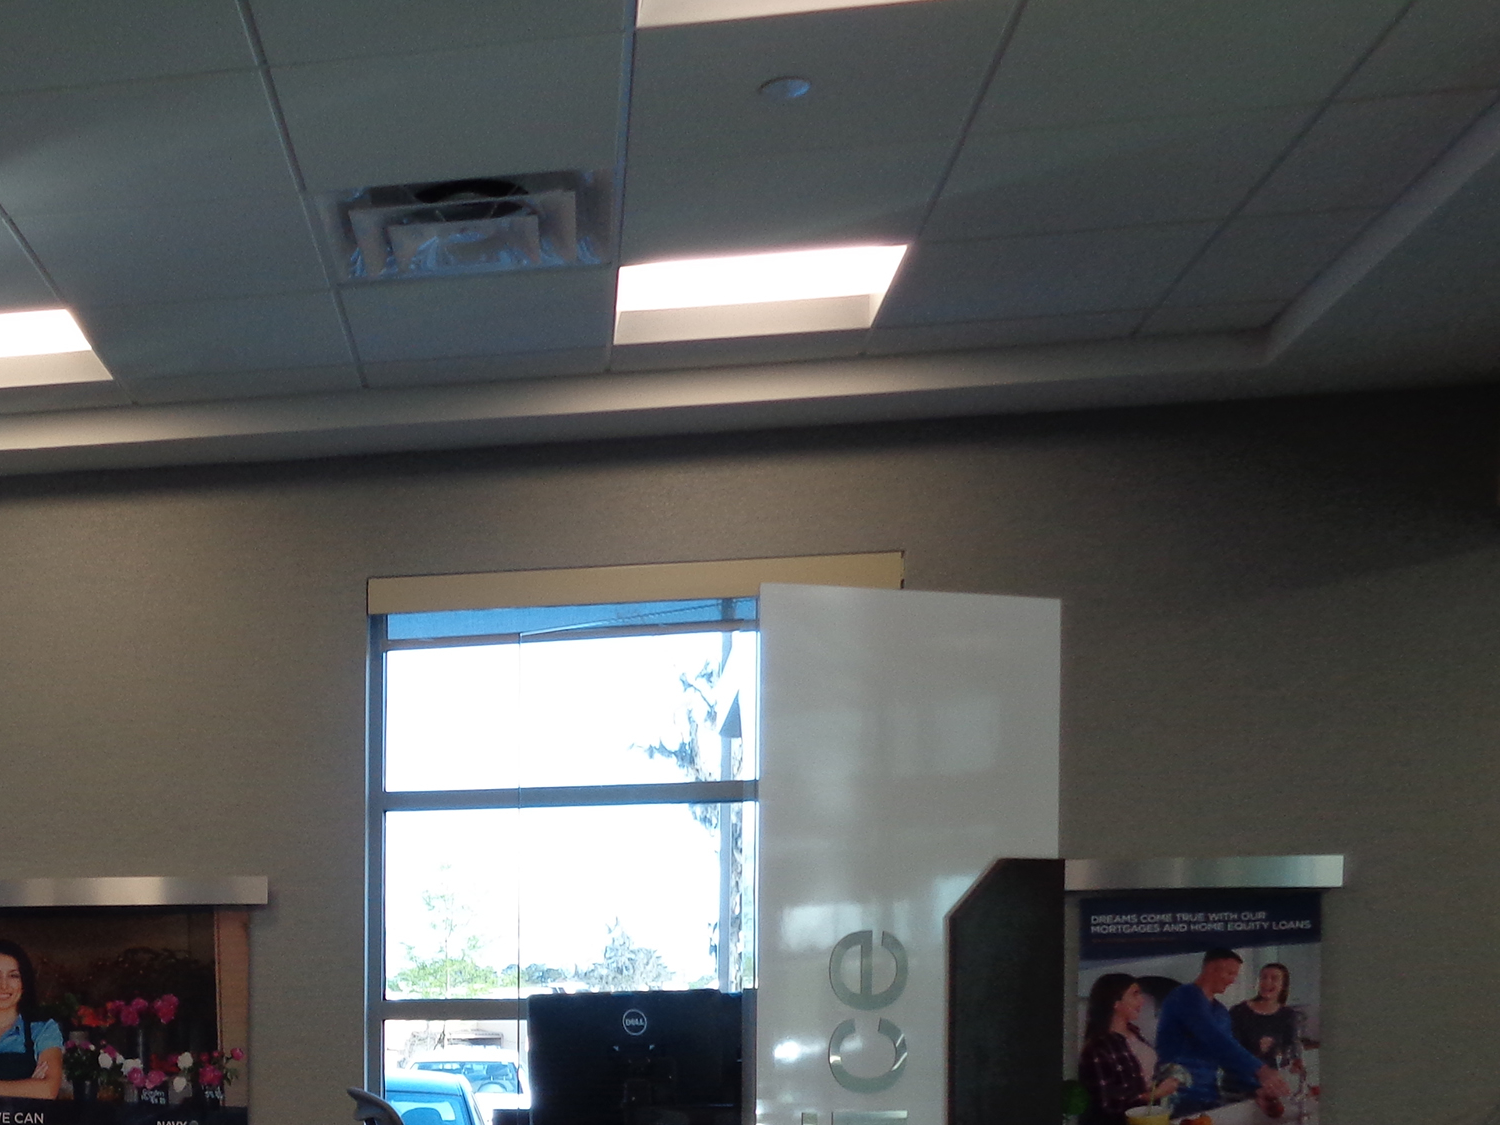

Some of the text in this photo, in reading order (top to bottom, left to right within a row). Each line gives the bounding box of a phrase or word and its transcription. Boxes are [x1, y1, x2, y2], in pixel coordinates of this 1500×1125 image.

[1090, 911, 1266, 925] DREAMS COME TRUE WITH OUR
[1090, 920, 1311, 934] MORTGAGES AND HOME EQUITY LOANS
[625, 1018, 645, 1026] DELL
[14, 1112, 44, 1124] CAN
